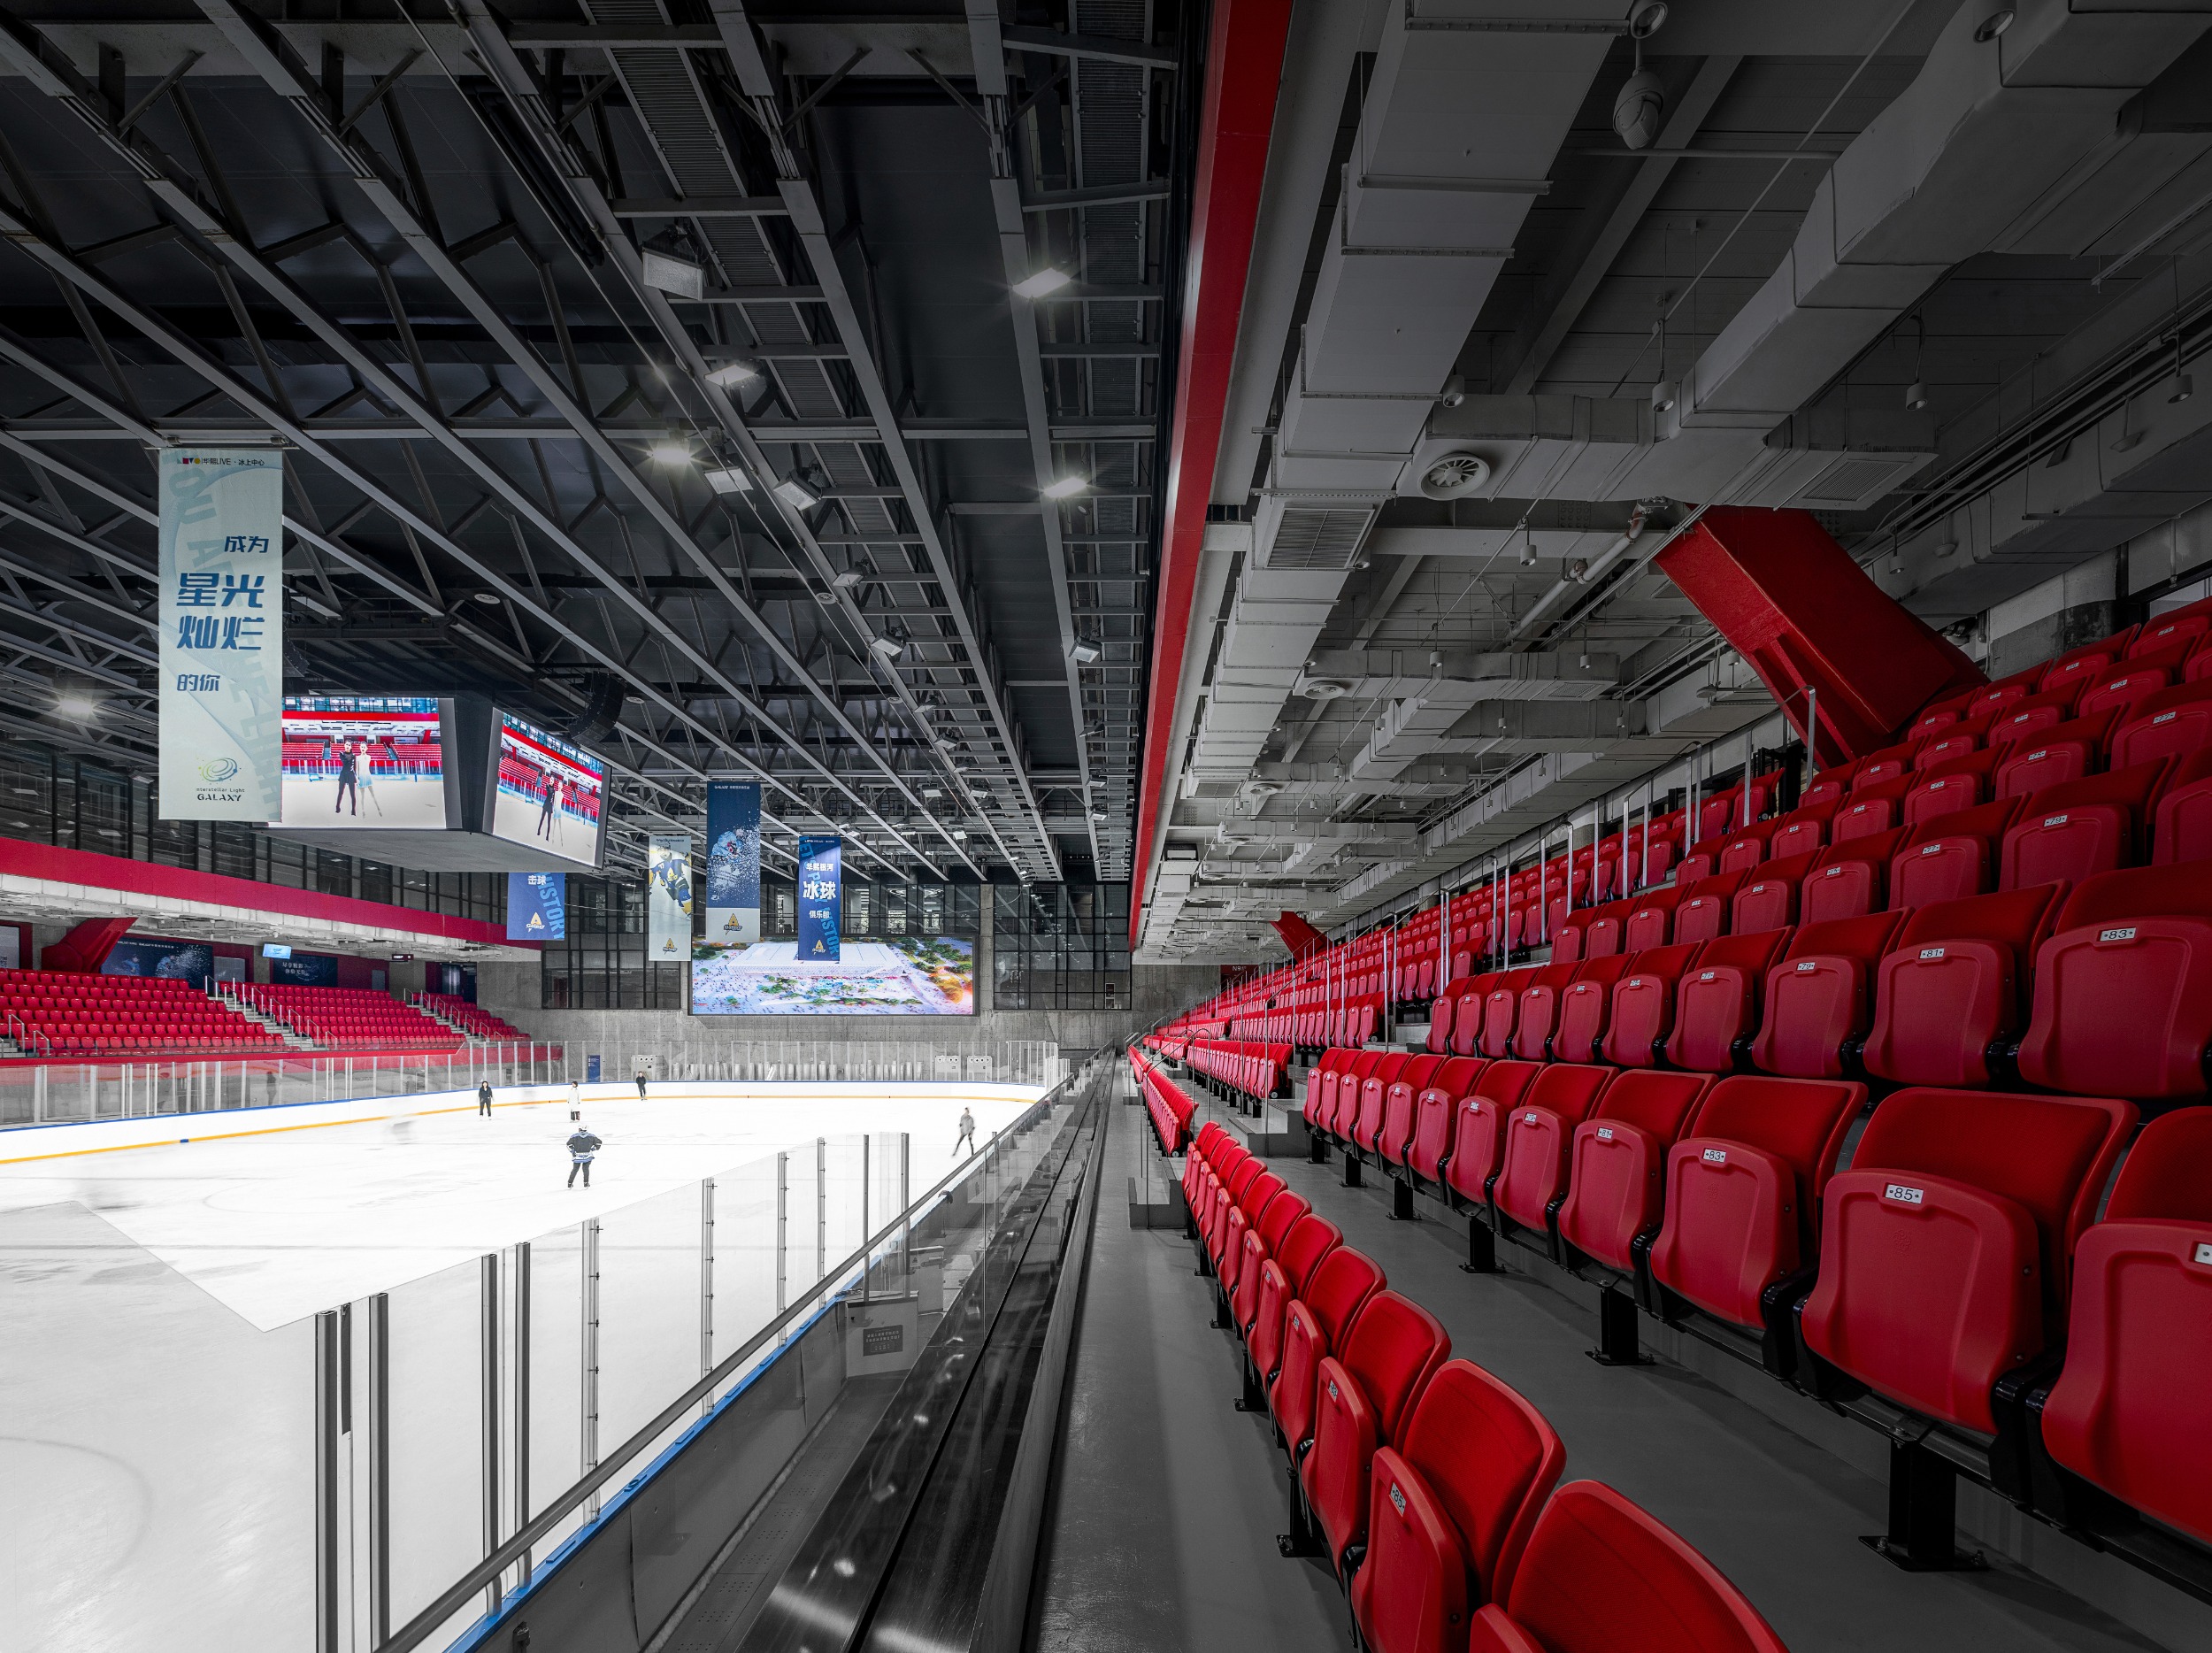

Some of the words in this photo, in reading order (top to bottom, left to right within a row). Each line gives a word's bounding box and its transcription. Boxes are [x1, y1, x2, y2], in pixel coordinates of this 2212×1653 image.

[224, 535, 269, 553] 成为
[176, 573, 265, 608] 星光
[177, 615, 265, 650] 灿烂
[177, 674, 220, 691] 的你
[197, 793, 242, 802] GALAXY
[803, 880, 836, 900] 冰球
[809, 910, 830, 919] 俱乐部
[2108, 929, 2127, 940] 83
[1709, 1150, 1721, 1161] 83
[1894, 1188, 1913, 1201] 85
[1394, 1489, 1404, 1509] 85
